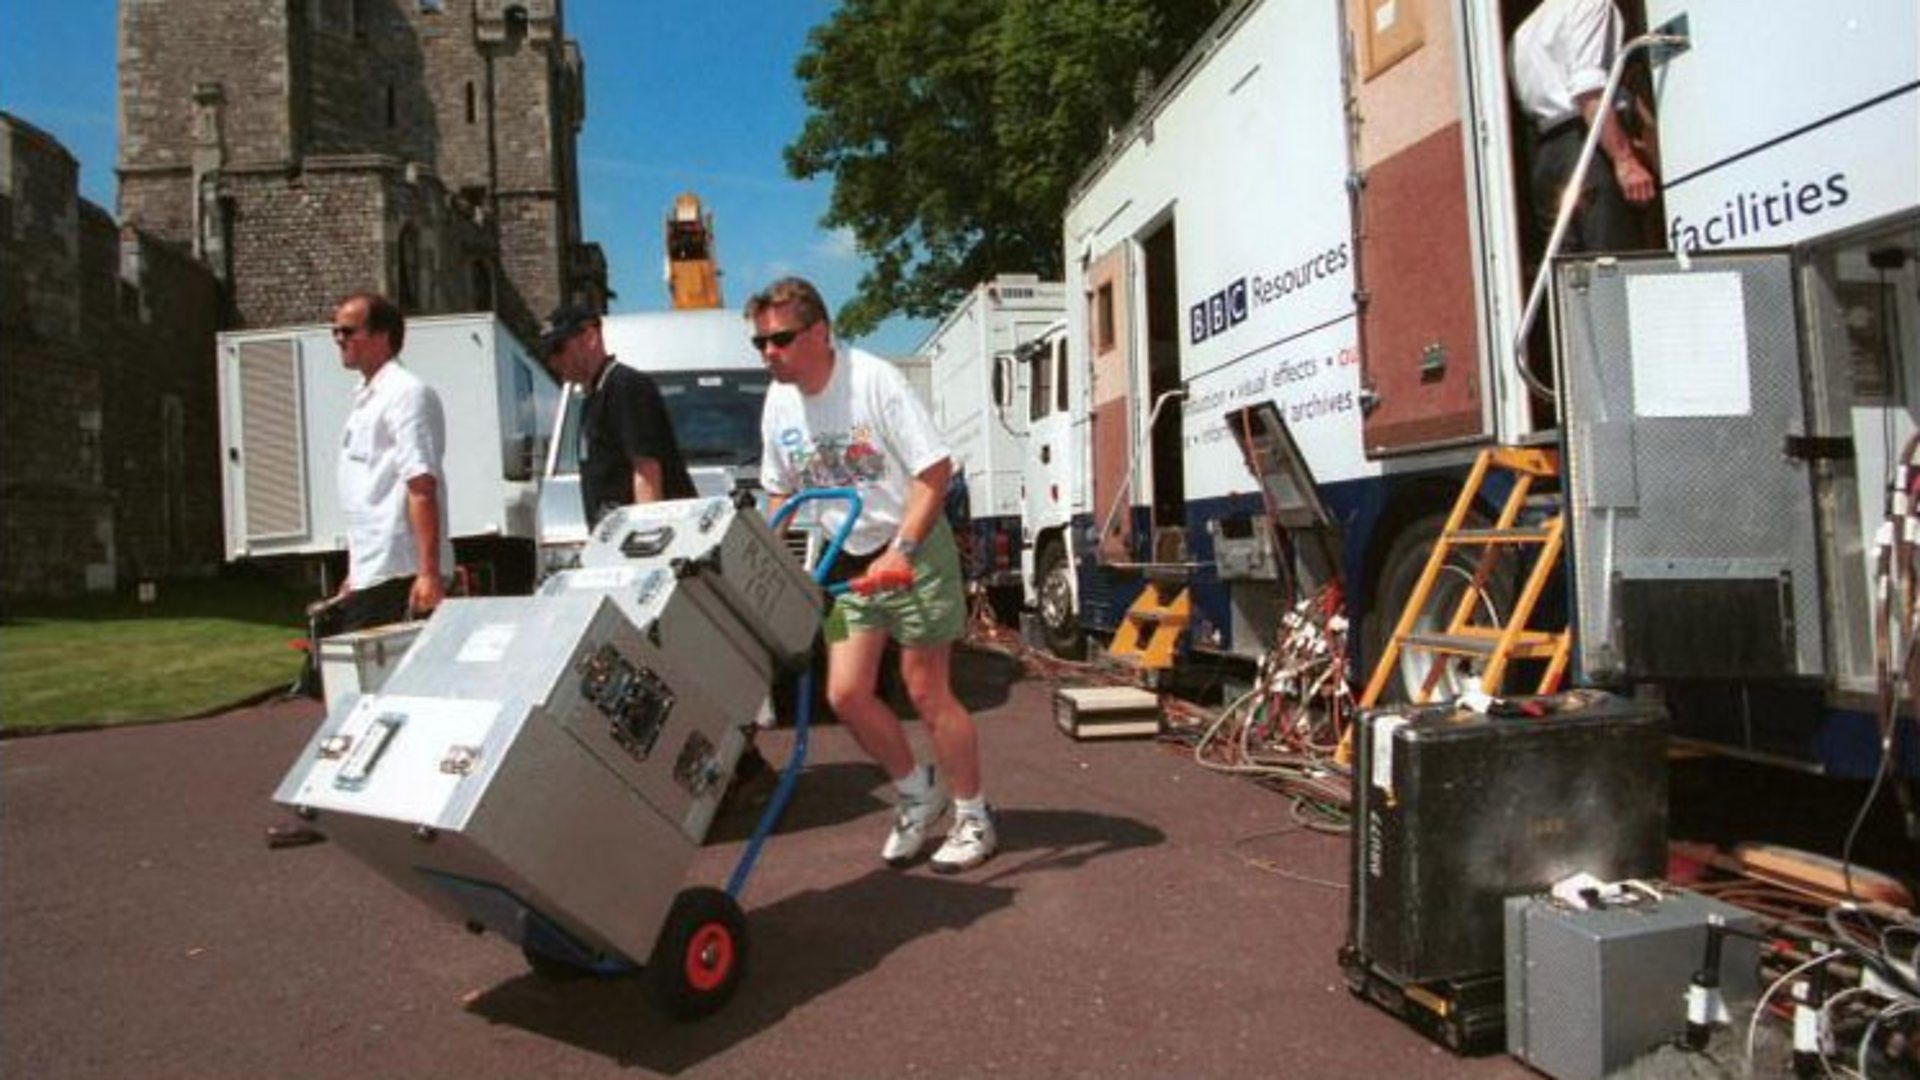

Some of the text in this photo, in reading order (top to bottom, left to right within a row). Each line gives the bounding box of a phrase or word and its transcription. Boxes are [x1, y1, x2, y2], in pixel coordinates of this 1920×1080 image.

[1669, 172, 1850, 251] facilities
[1190, 243, 1348, 345] BBC Resources
[1271, 359, 1317, 388] effects
[1290, 389, 1354, 423] archives
